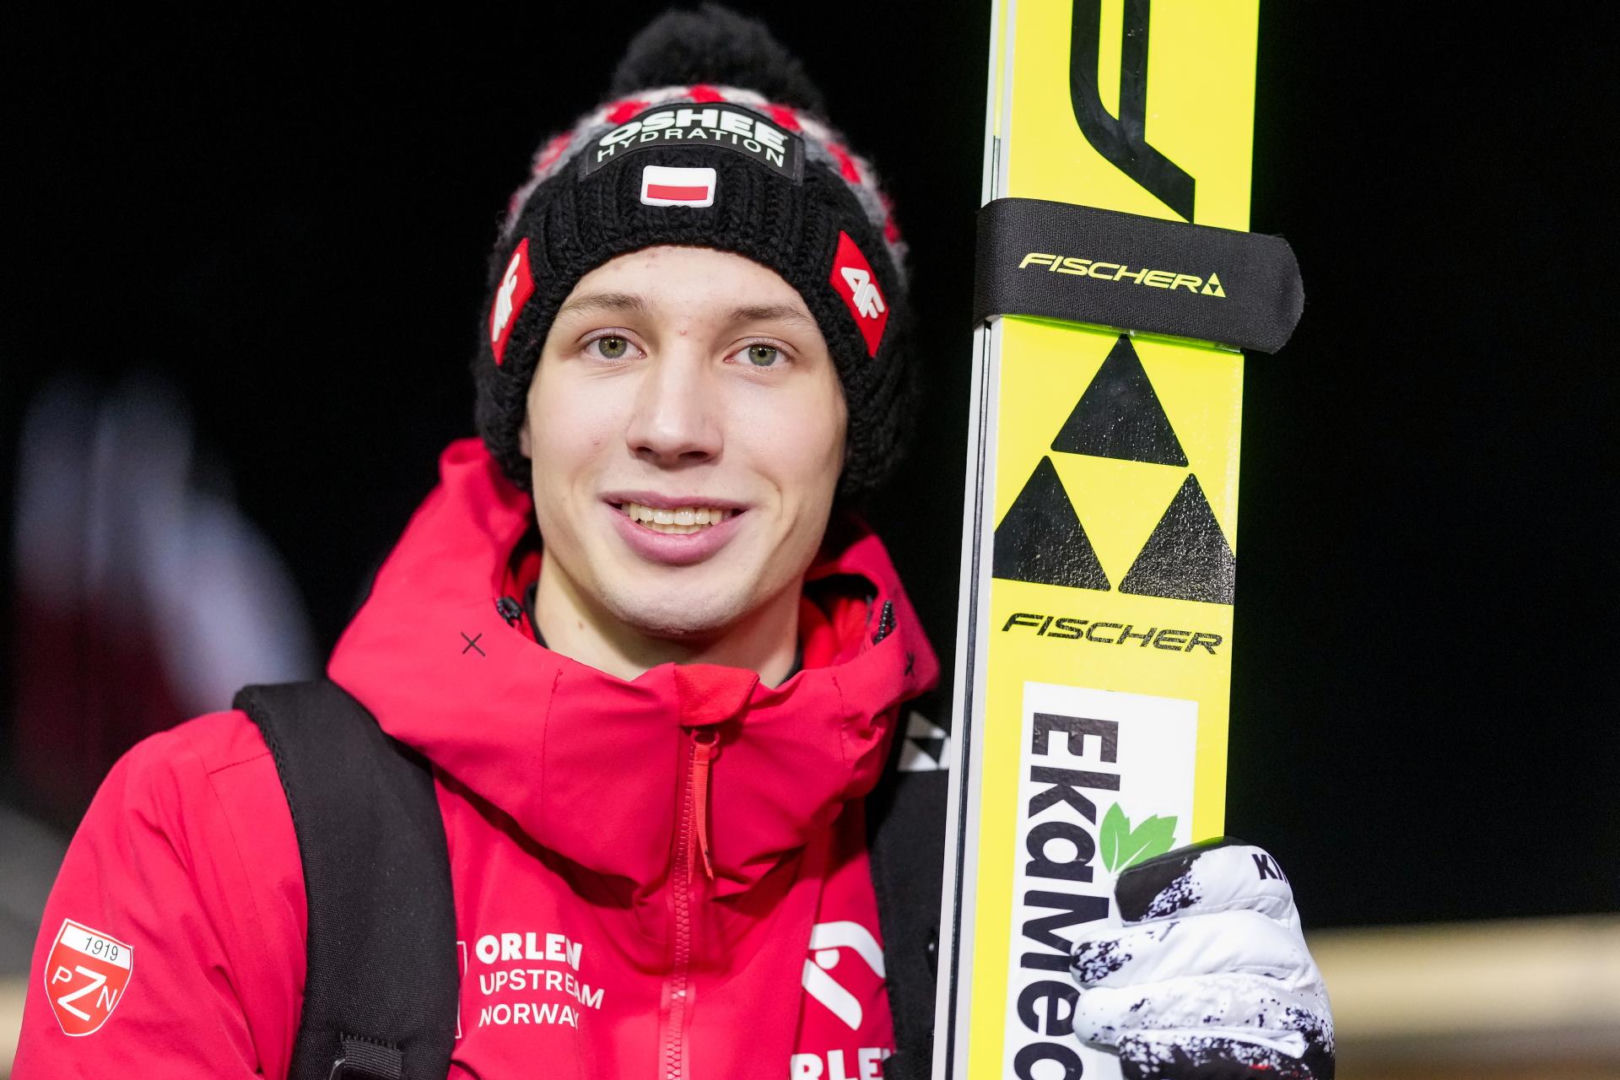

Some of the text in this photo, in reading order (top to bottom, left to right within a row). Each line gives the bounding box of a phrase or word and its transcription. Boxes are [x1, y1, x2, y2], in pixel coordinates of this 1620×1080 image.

[597, 127, 785, 168] HYDRATION
[599, 109, 789, 155] OSHEE
[840, 266, 886, 319] 4F
[1018, 252, 1203, 294] FISCHER
[1001, 612, 1223, 655] FISCHER
[84, 936, 119, 962] 1919
[475, 932, 583, 971] ORLEN
[479, 968, 605, 1010] UPSTREAM
[790, 1047, 892, 1080] RLE
